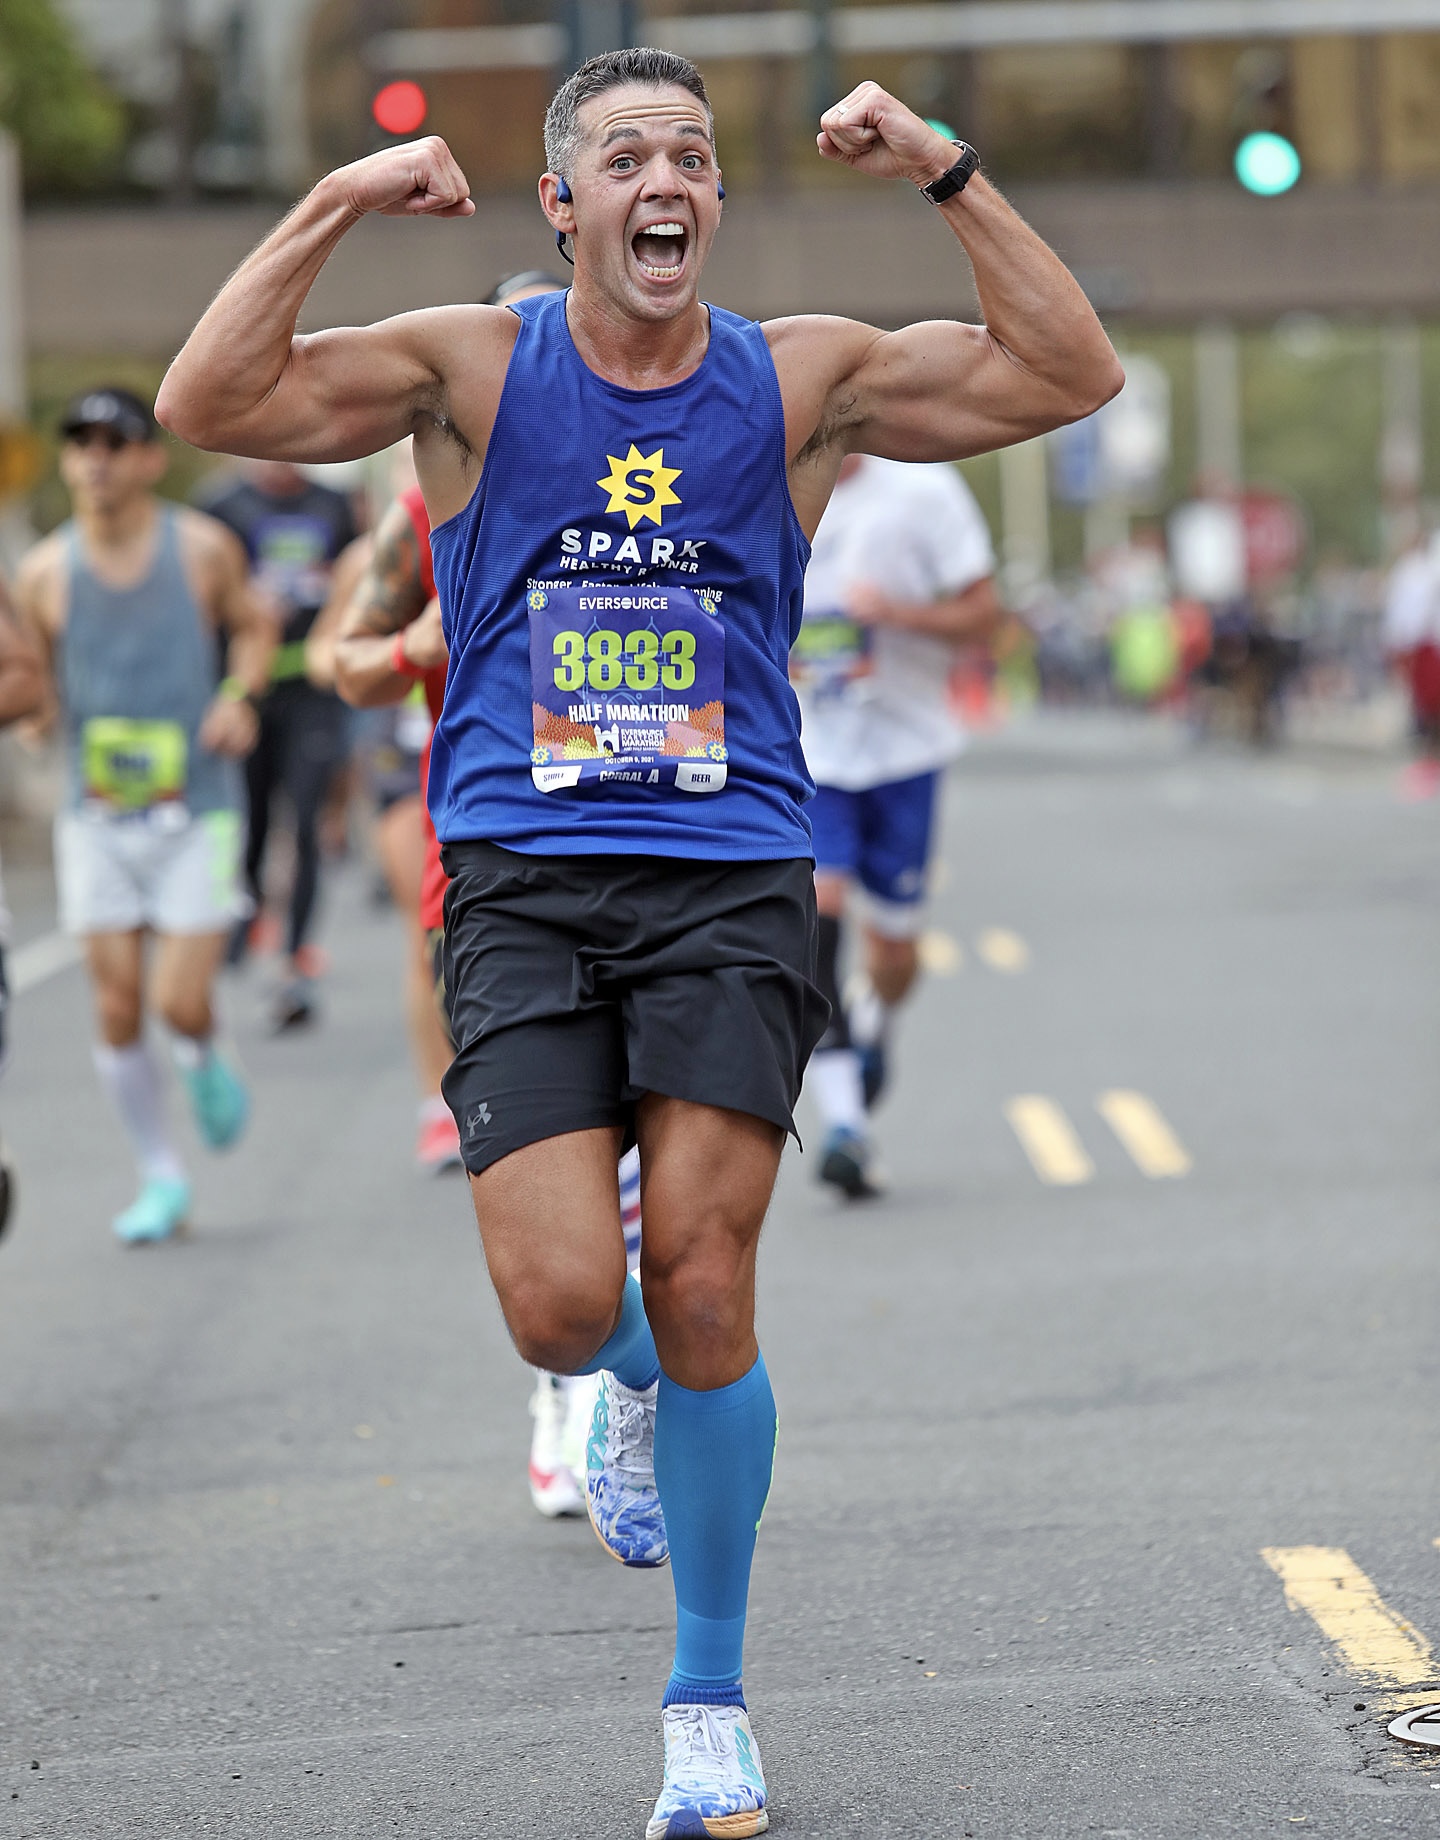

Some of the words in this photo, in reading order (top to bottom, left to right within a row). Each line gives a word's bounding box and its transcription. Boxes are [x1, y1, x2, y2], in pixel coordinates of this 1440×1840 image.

[624, 468, 656, 505] S
[560, 528, 707, 564] SPARK
[560, 555, 633, 575] HEALTHY
[637, 559, 699, 577] RNER
[526, 577, 572, 590] Stronger
[579, 596, 668, 611] EVERSOURCE
[552, 629, 697, 692] 3833
[568, 704, 603, 723] HALF
[607, 704, 689, 722] MARATHON
[600, 770, 643, 782] CORRAL
[646, 768, 659, 783] A
[691, 773, 711, 783] BEER
